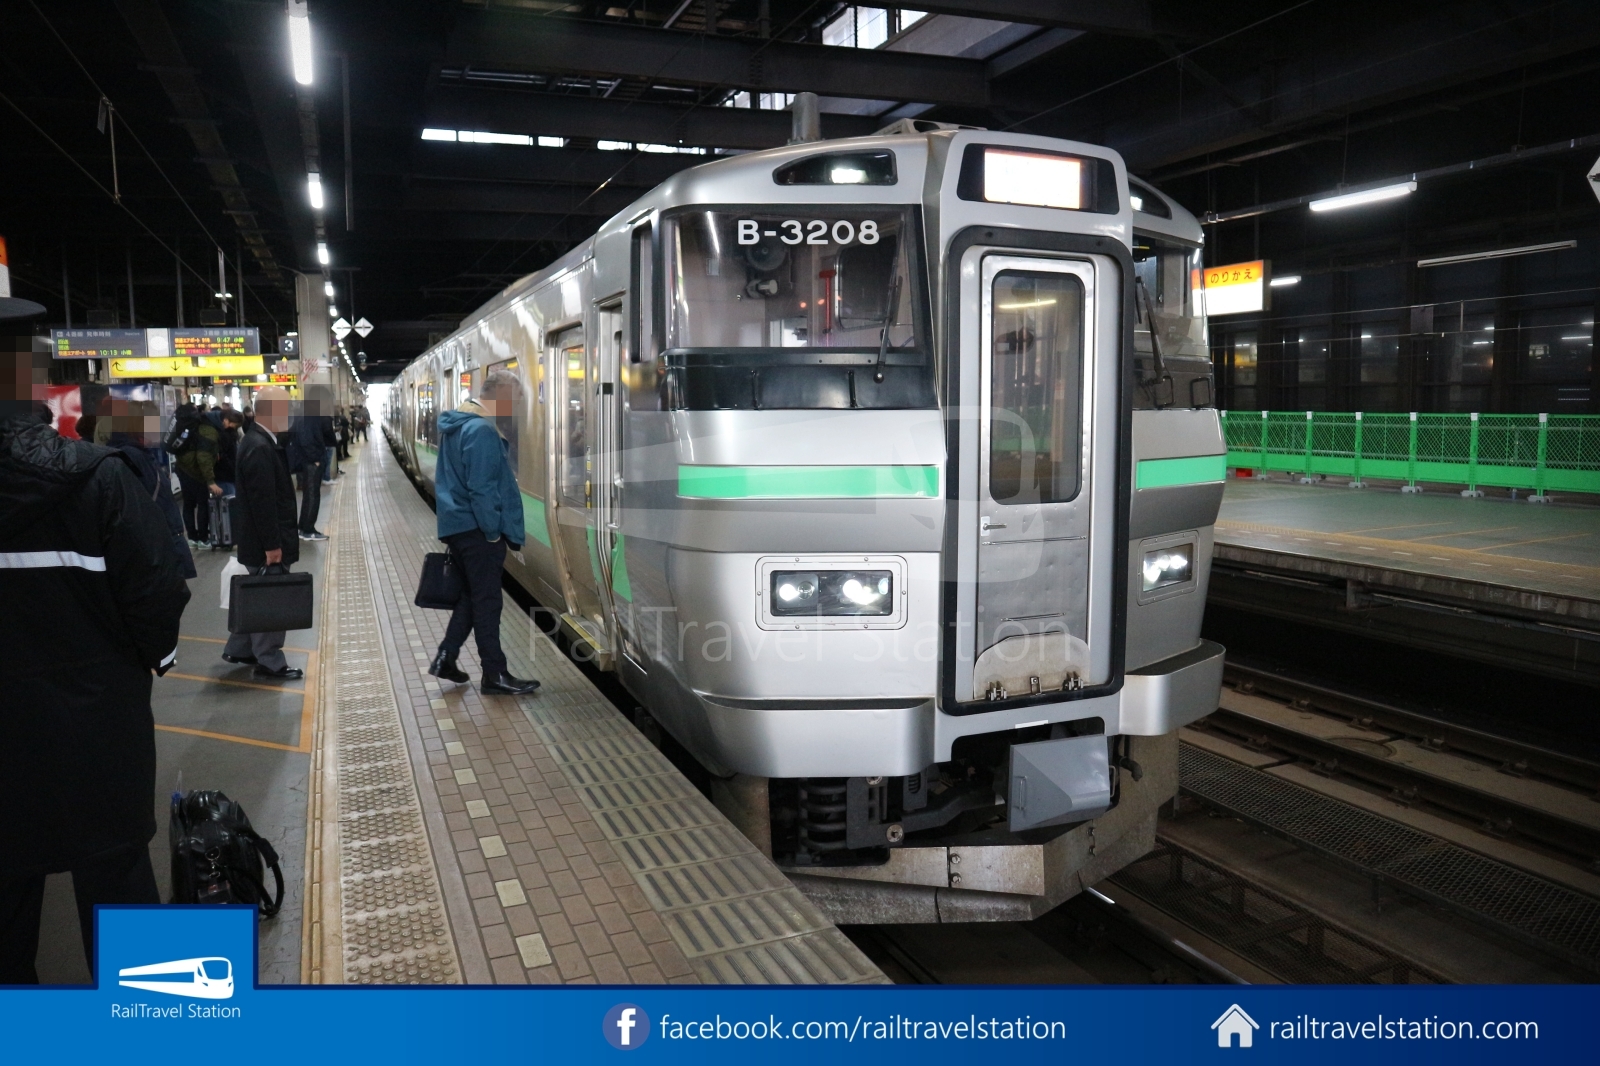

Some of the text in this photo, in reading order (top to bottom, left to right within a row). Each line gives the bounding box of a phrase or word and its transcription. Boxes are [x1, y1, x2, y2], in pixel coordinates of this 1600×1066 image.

[738, 220, 880, 245] B-3208
[1210, 269, 1252, 283] のりかえ
[284, 339, 293, 351] 3
